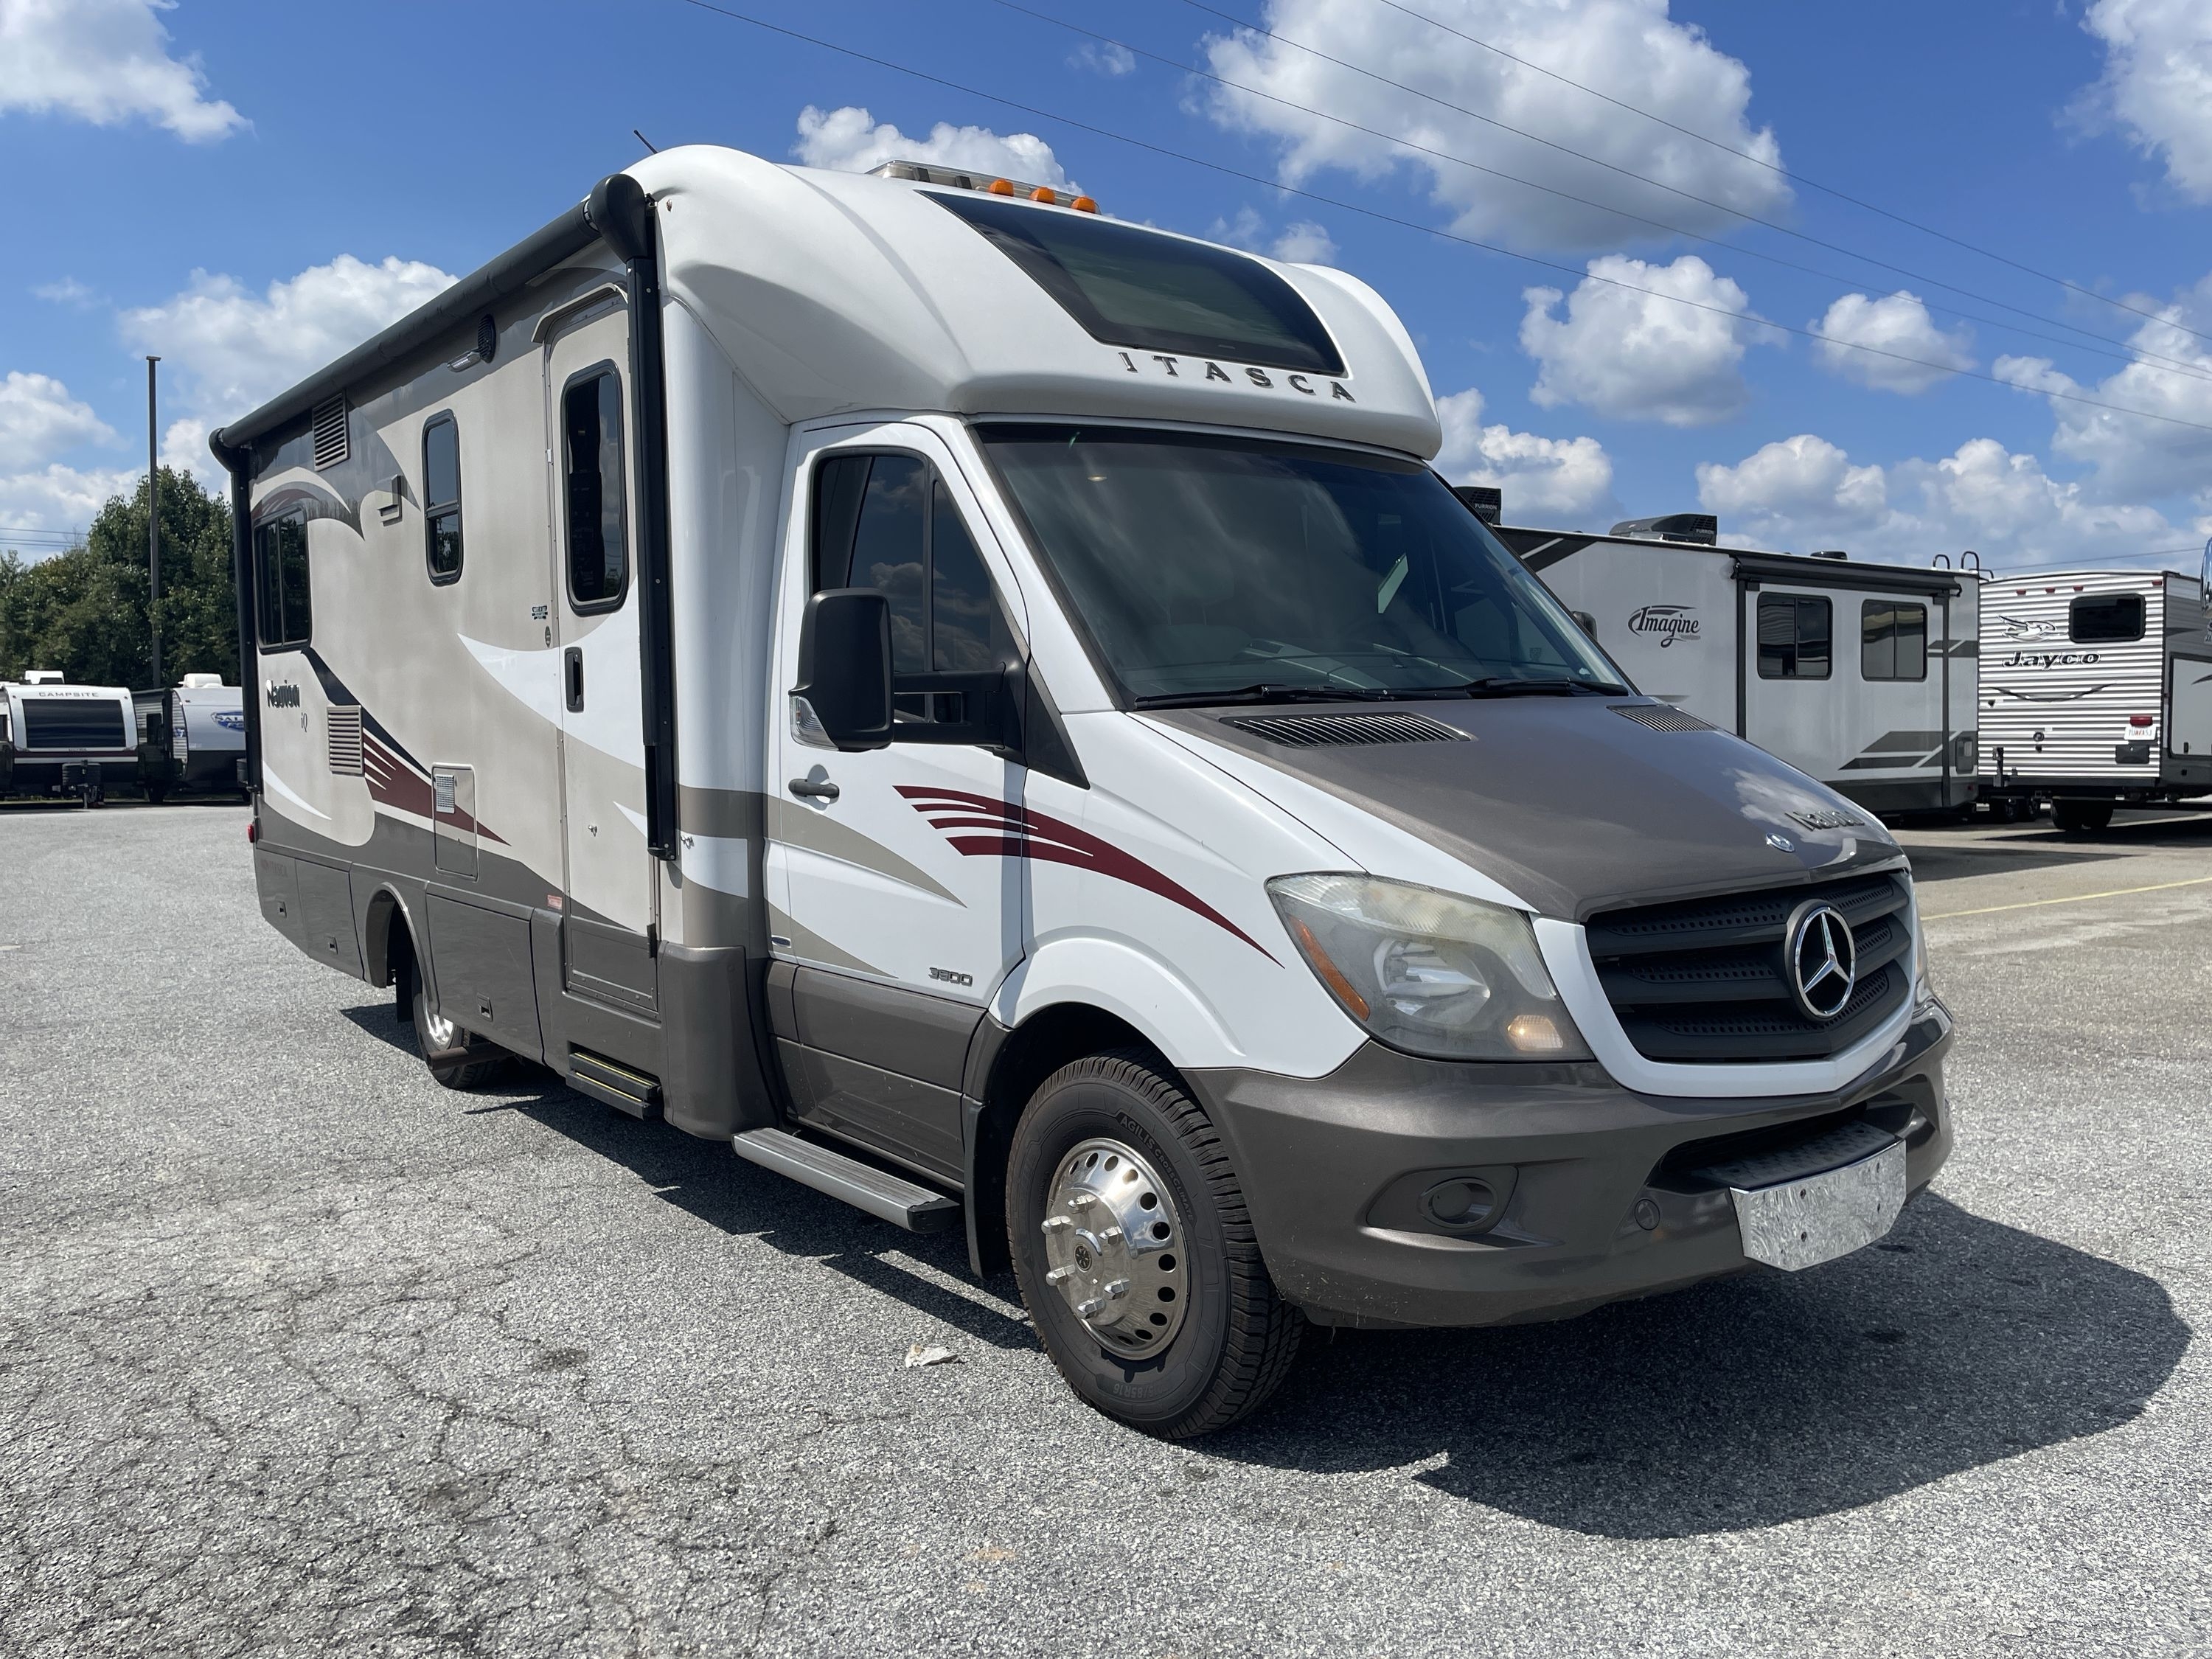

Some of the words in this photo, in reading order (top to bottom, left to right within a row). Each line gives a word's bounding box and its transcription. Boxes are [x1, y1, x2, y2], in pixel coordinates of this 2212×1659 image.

[1118, 351, 1356, 403] ITASCA
[1475, 503, 1498, 511] FURRION
[1635, 605, 1701, 648] Imagine
[2003, 651, 2101, 671] Jayco
[301, 712, 308, 733] iQ
[928, 967, 973, 987] 3500
[1120, 1116, 1155, 1150] AGILIS
